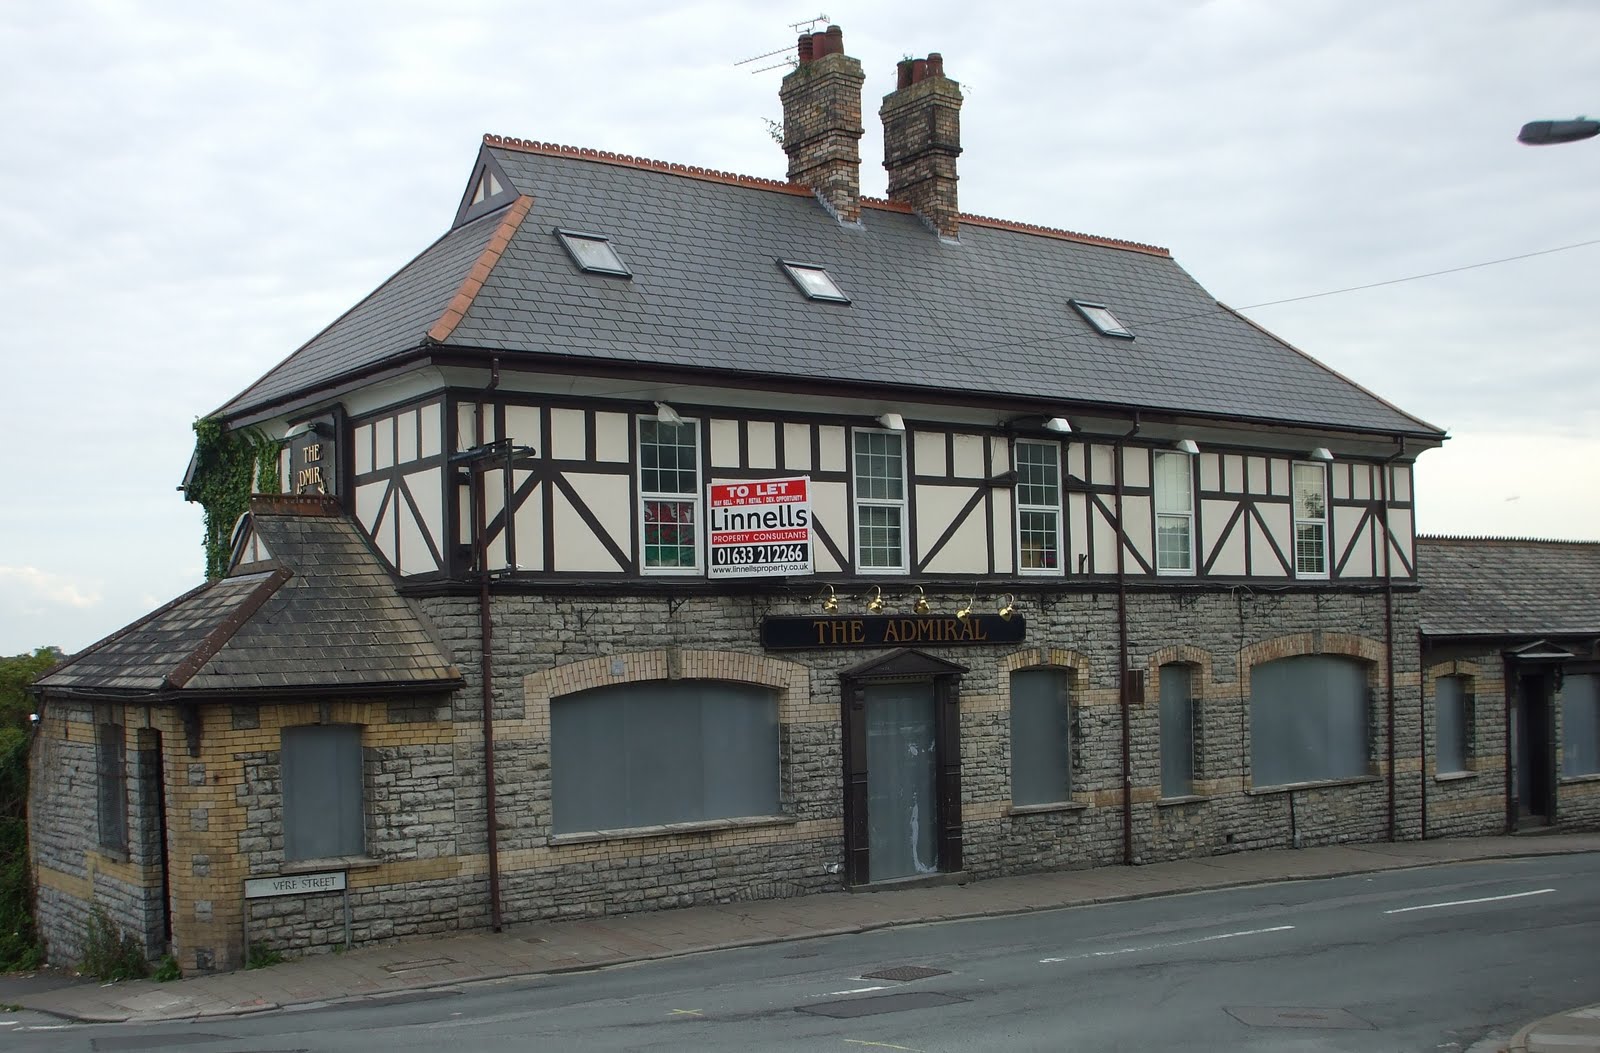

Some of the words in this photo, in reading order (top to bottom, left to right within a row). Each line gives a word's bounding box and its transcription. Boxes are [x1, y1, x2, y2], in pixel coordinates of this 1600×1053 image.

[303, 444, 320, 463] THE
[727, 486, 749, 497] TO
[756, 483, 788, 495] LET
[711, 505, 807, 531] Linnells
[713, 534, 749, 543] PROPERTY
[753, 531, 806, 541] CONSULTANTS
[718, 547, 754, 564] 01633
[757, 544, 802, 562] 212266
[712, 563, 808, 573] www.linnellsproperty.co.uk
[813, 620, 864, 644] THE
[883, 619, 987, 642] ADMIRAL
[301, 877, 336, 888] STREET
